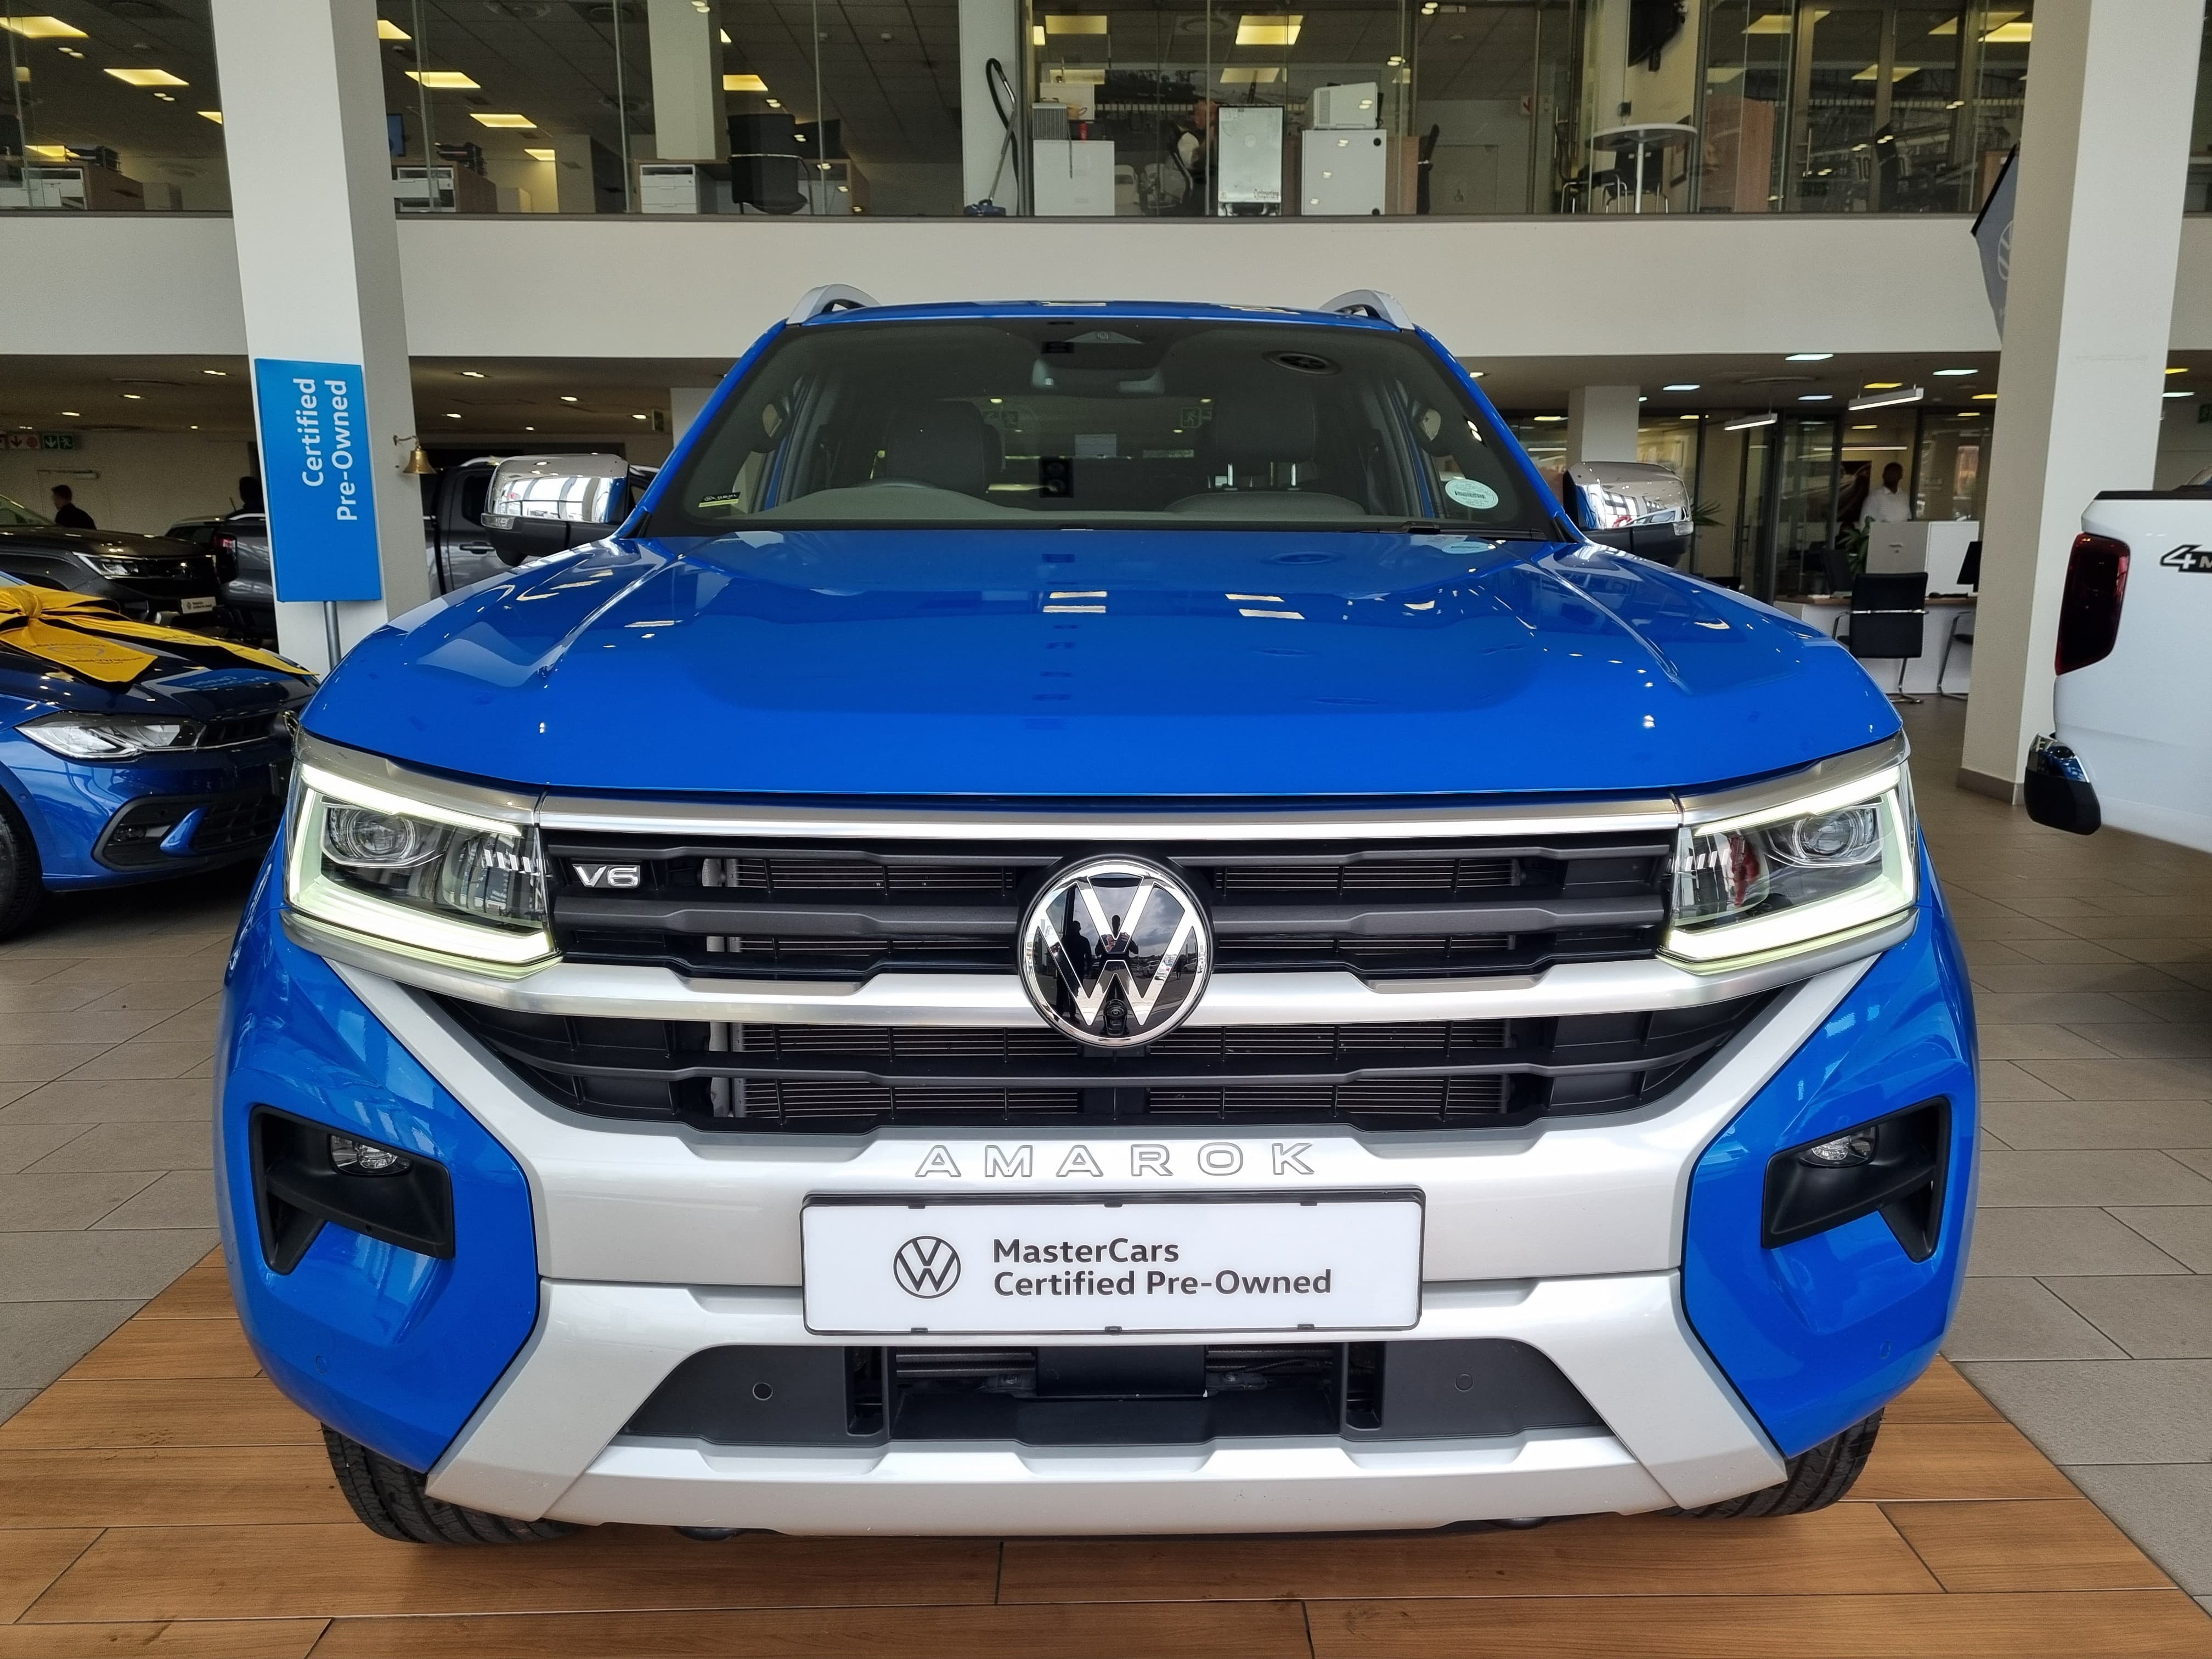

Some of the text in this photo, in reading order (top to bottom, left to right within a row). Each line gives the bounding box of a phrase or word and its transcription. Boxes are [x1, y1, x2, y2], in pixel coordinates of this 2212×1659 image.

[292, 378, 324, 487] Certified
[324, 380, 358, 521] Pre-Owned
[572, 865, 639, 887] V6
[915, 1142, 1315, 1178] AMAROK
[994, 1238, 1179, 1263] MasterCars
[994, 1268, 1331, 1296] Certified Pre-Owned
